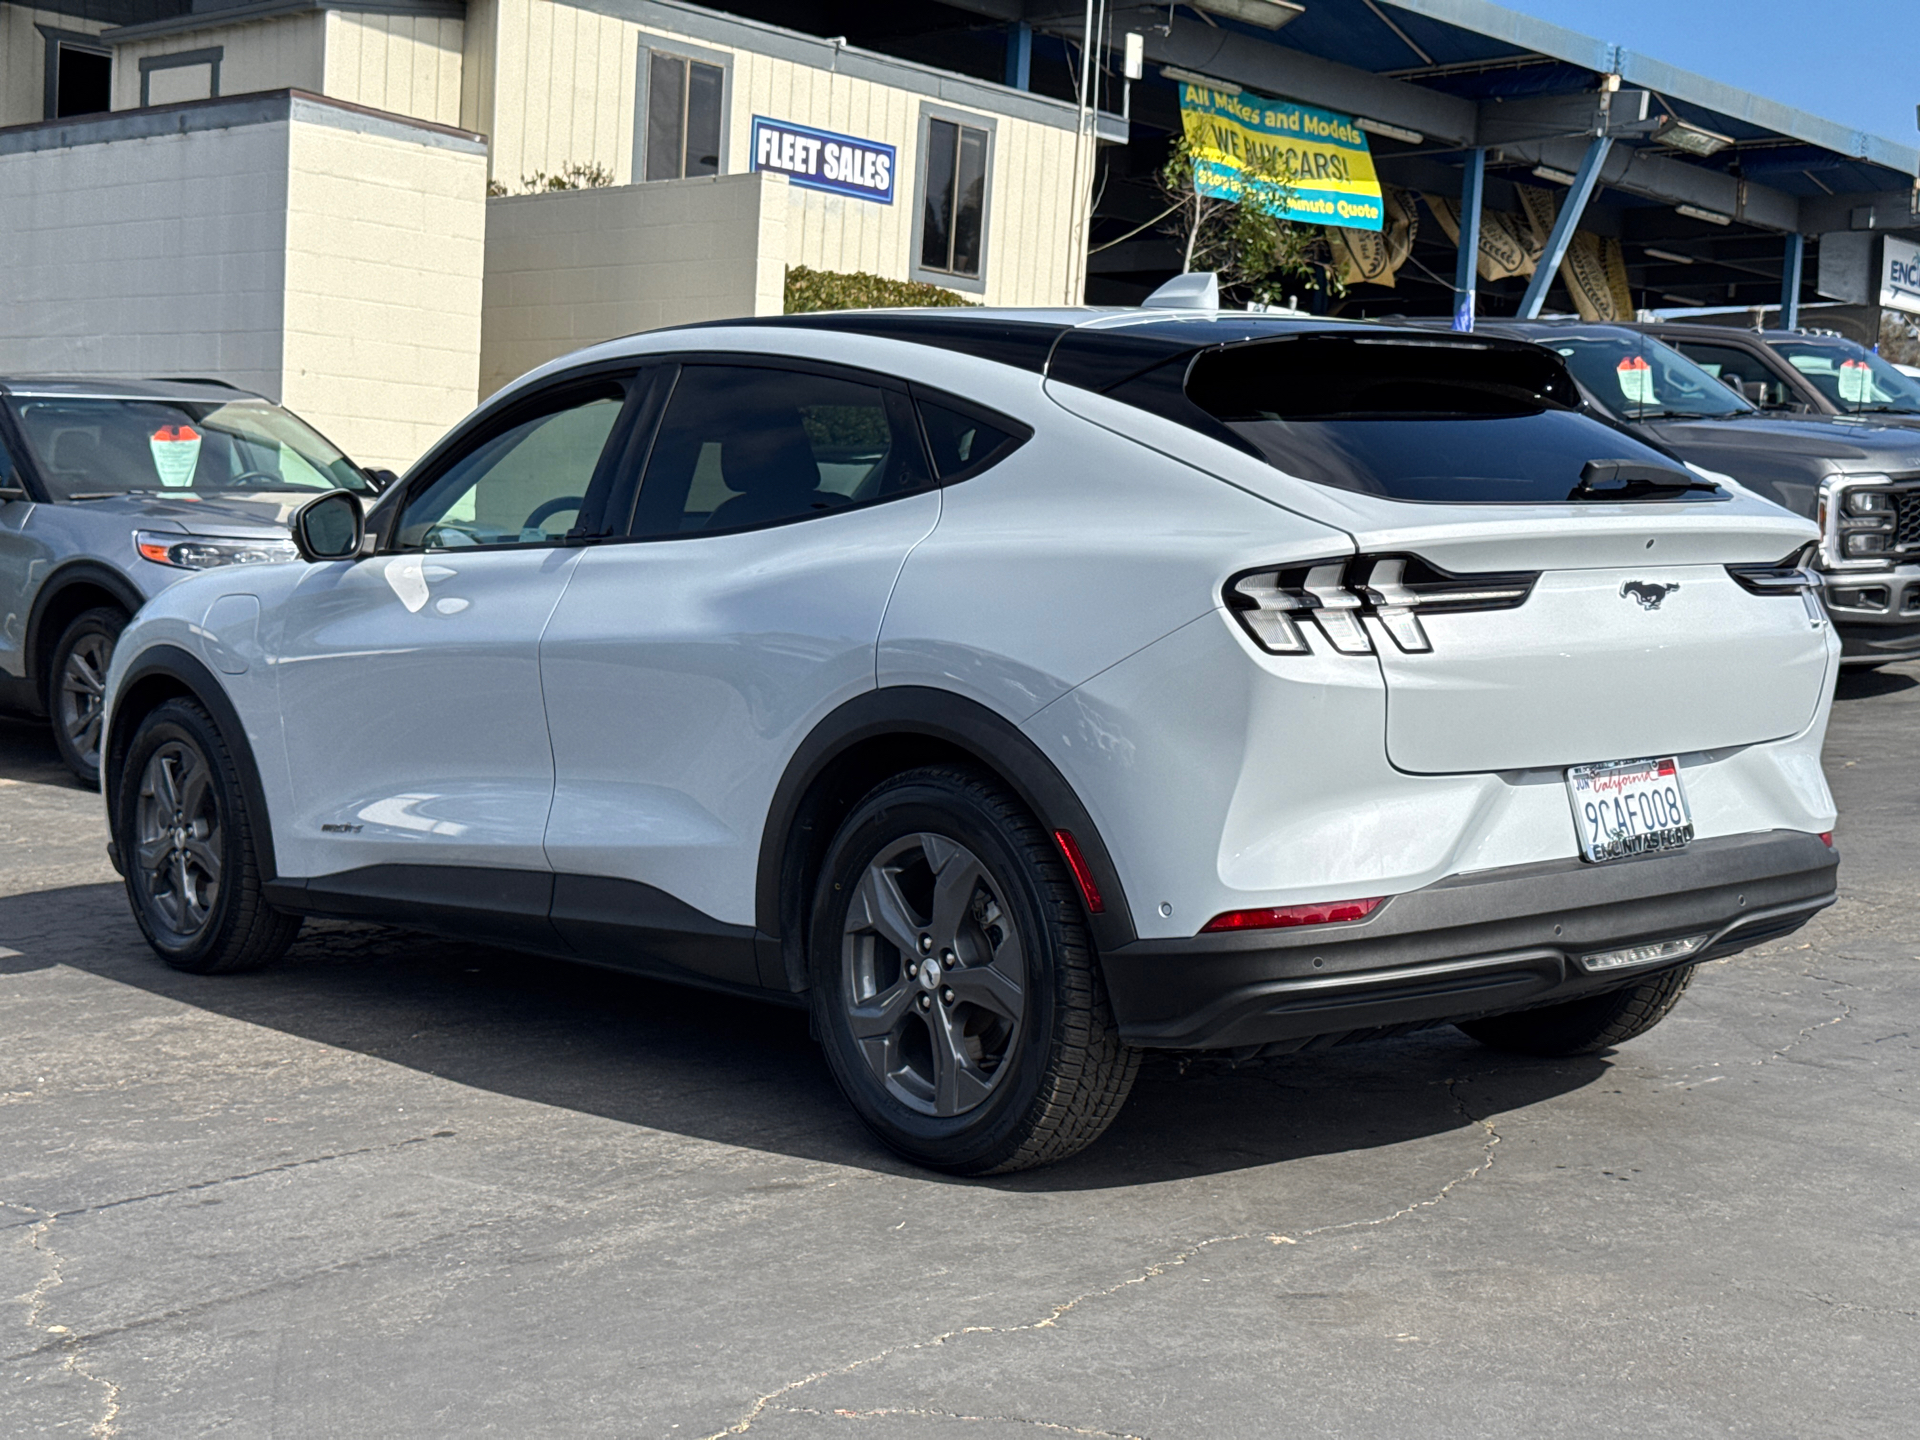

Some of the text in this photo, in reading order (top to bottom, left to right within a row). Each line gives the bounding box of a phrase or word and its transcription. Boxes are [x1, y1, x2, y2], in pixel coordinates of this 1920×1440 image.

[1185, 84, 1362, 145] All Makes and Models
[757, 127, 891, 191] FLEET SALES
[1210, 123, 1242, 161] WE
[1284, 147, 1350, 180] CARS!
[1337, 200, 1379, 219] Quote
[1890, 260, 1920, 288] ENC
[1591, 769, 1660, 795] California
[1584, 786, 1681, 843] 9CAF008
